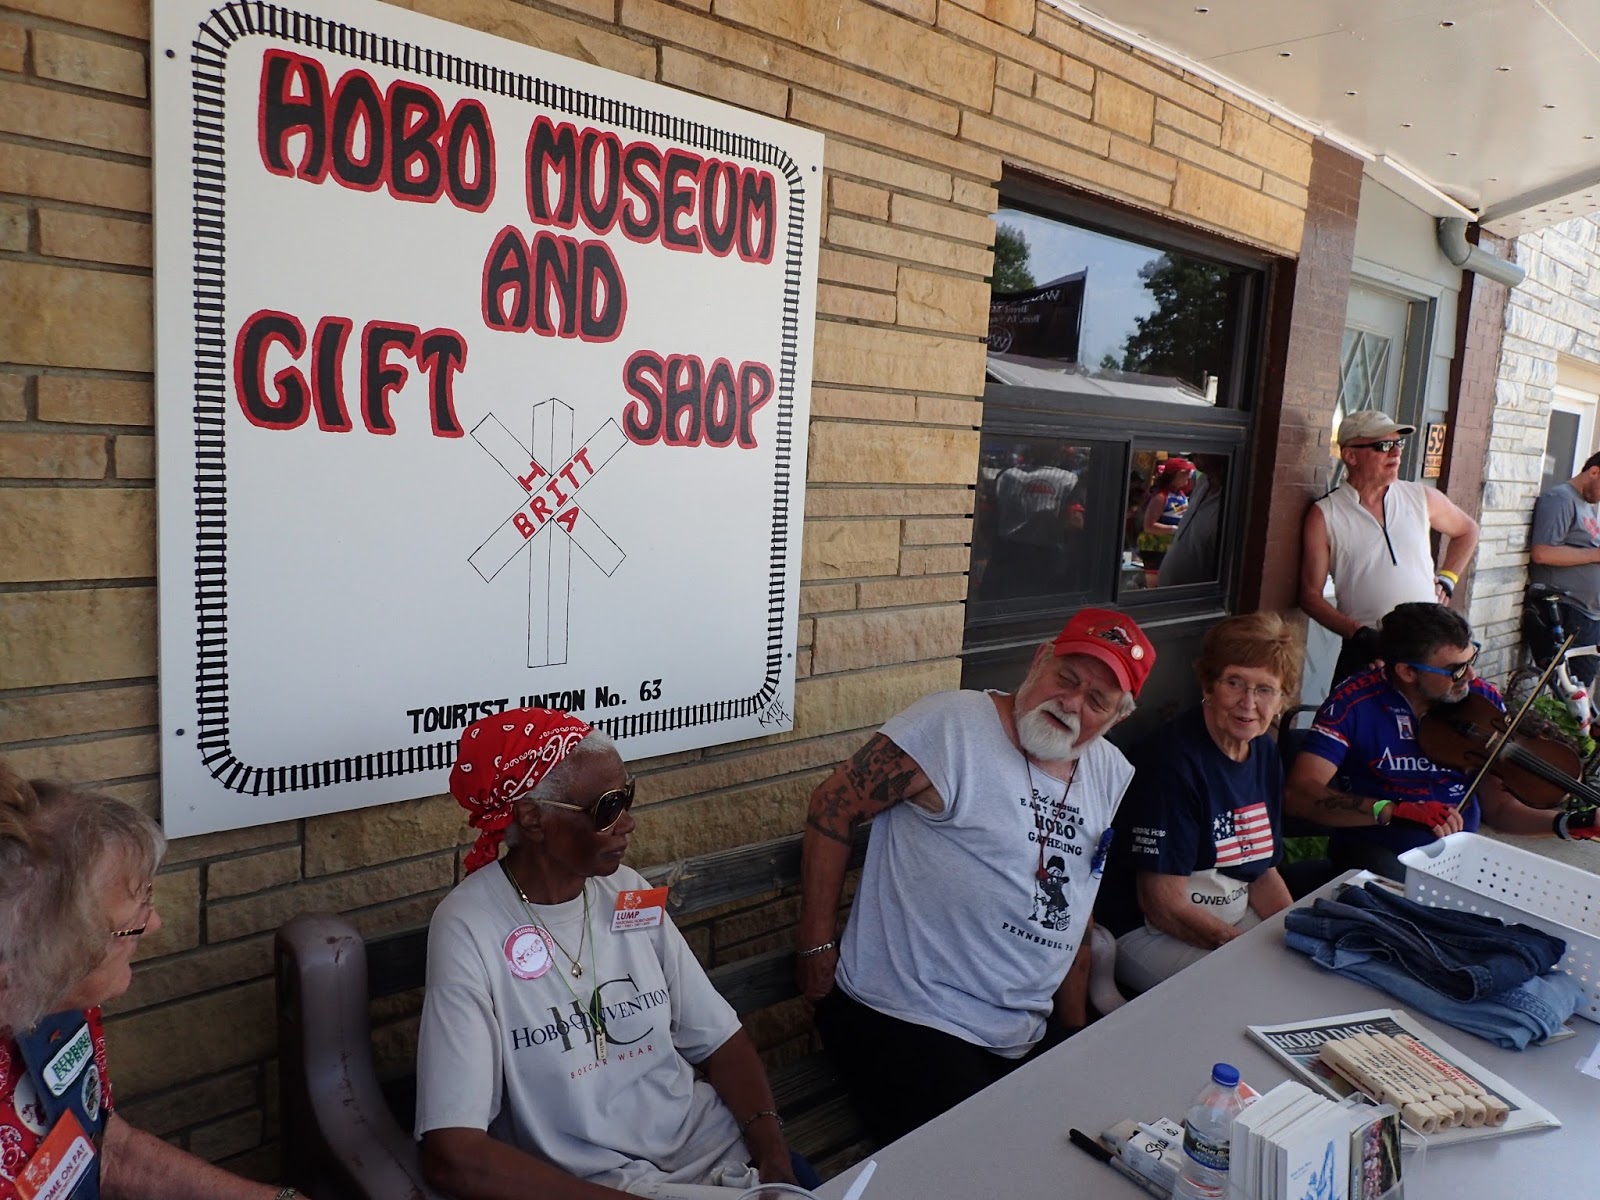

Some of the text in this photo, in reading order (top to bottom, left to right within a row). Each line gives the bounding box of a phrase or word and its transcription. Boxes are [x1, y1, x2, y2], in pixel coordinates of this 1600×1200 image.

[258, 48, 777, 264] HOBO MUSEUM
[481, 224, 627, 343] AND
[234, 309, 775, 449] GIFT SHOP
[1428, 426, 1444, 454] 59
[512, 447, 595, 539] BRITT
[407, 679, 662, 734] TOURIST UNION No. 63
[1020, 797, 1048, 814] EAST
[1028, 831, 1083, 856] GATHEING
[1034, 813, 1076, 840] HOBO
[616, 911, 640, 920] LUMP
[1191, 892, 1231, 906] OWENS
[52, 1031, 89, 1072] REDBIRD
[1267, 1031, 1330, 1049] HOBO
[1326, 1023, 1380, 1040] DAYS
[570, 1058, 608, 1079] BOXCAR
[618, 1044, 653, 1061] WEAR
[1145, 1128, 1179, 1161] Shaie
[61, 1163, 73, 1180] ON
[72, 1144, 85, 1164] PAT
